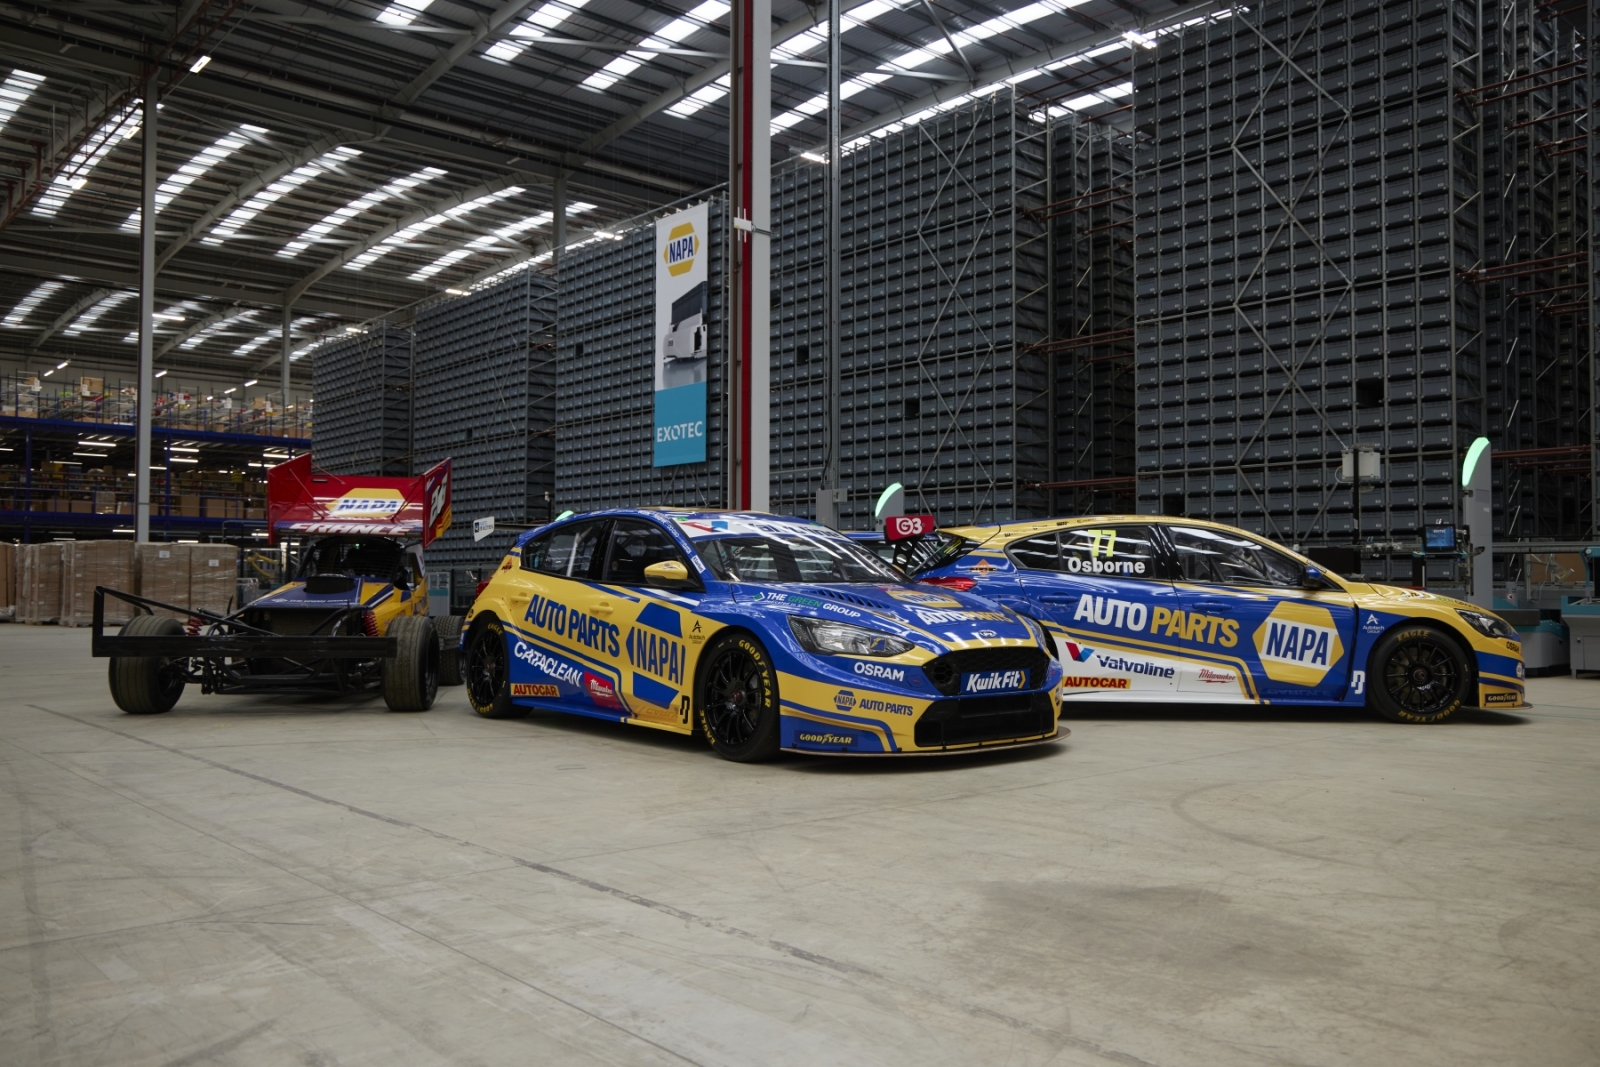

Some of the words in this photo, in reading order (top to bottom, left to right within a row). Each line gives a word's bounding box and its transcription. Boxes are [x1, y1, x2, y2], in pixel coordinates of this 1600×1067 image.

[669, 235, 694, 264] NAPA
[656, 421, 703, 443] EXOTEC
[337, 499, 398, 513] NAPA
[289, 522, 415, 535] FRANCE
[1087, 529, 1117, 558] 77
[1067, 557, 1146, 574] Osborne
[767, 592, 788, 602] THE
[788, 595, 823, 608] GREEN
[822, 603, 861, 618] GROUP
[524, 594, 567, 636] AUTO
[567, 608, 621, 658] PARTS
[1073, 593, 1148, 632] AUTO
[1149, 605, 1241, 648] PARTS
[1265, 622, 1329, 666] NAPA
[1397, 629, 1430, 641] EAGLE
[514, 641, 583, 687] CATACLEAN
[636, 628, 679, 685] NAPA
[1097, 655, 1175, 679] Valvoline
[853, 661, 905, 682] OSRAM
[1064, 676, 1128, 689] AUTOCAR
[513, 684, 558, 697] AUTOCAR
[836, 694, 854, 707] NAPA
[859, 698, 885, 712] AUTO
[885, 702, 914, 716] PARTS
